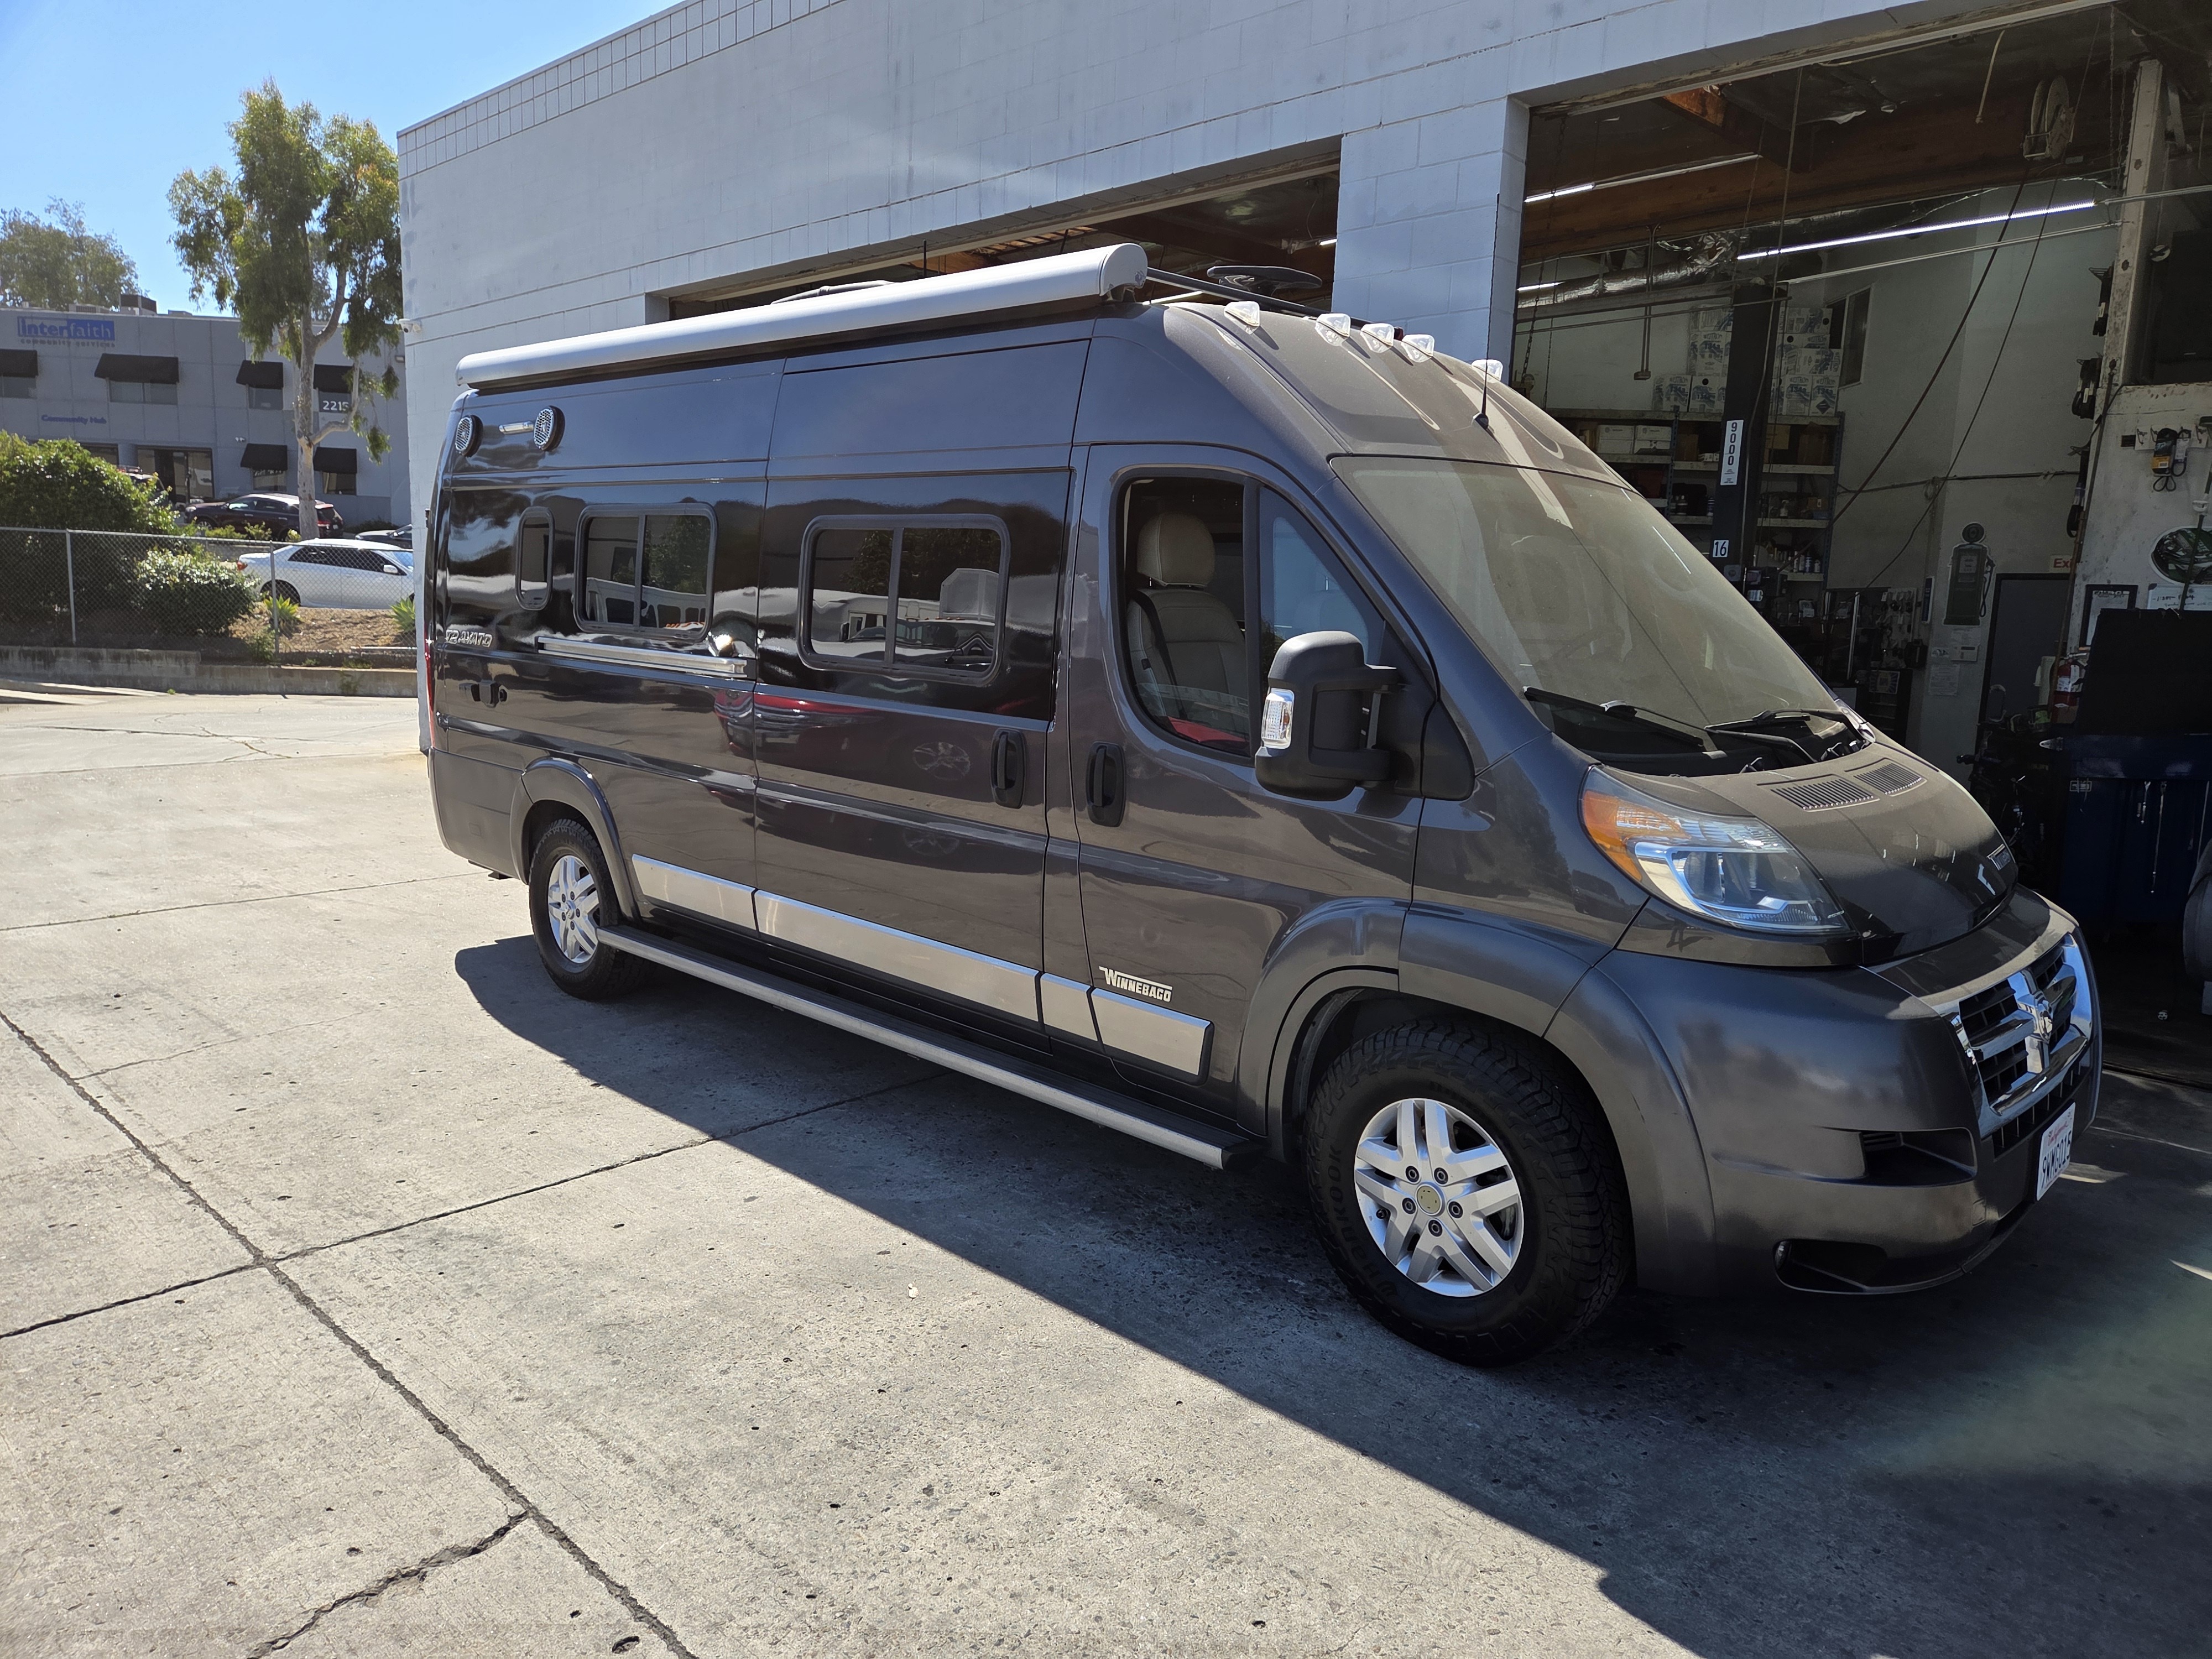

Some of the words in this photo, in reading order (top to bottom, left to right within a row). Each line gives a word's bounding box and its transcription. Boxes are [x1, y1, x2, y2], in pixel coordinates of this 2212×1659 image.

[322, 400, 349, 411] 2215
[41, 414, 88, 425] Community
[1727, 421, 1738, 466] 9000
[1714, 541, 1726, 556] 16
[446, 629, 493, 648] TRAVATO
